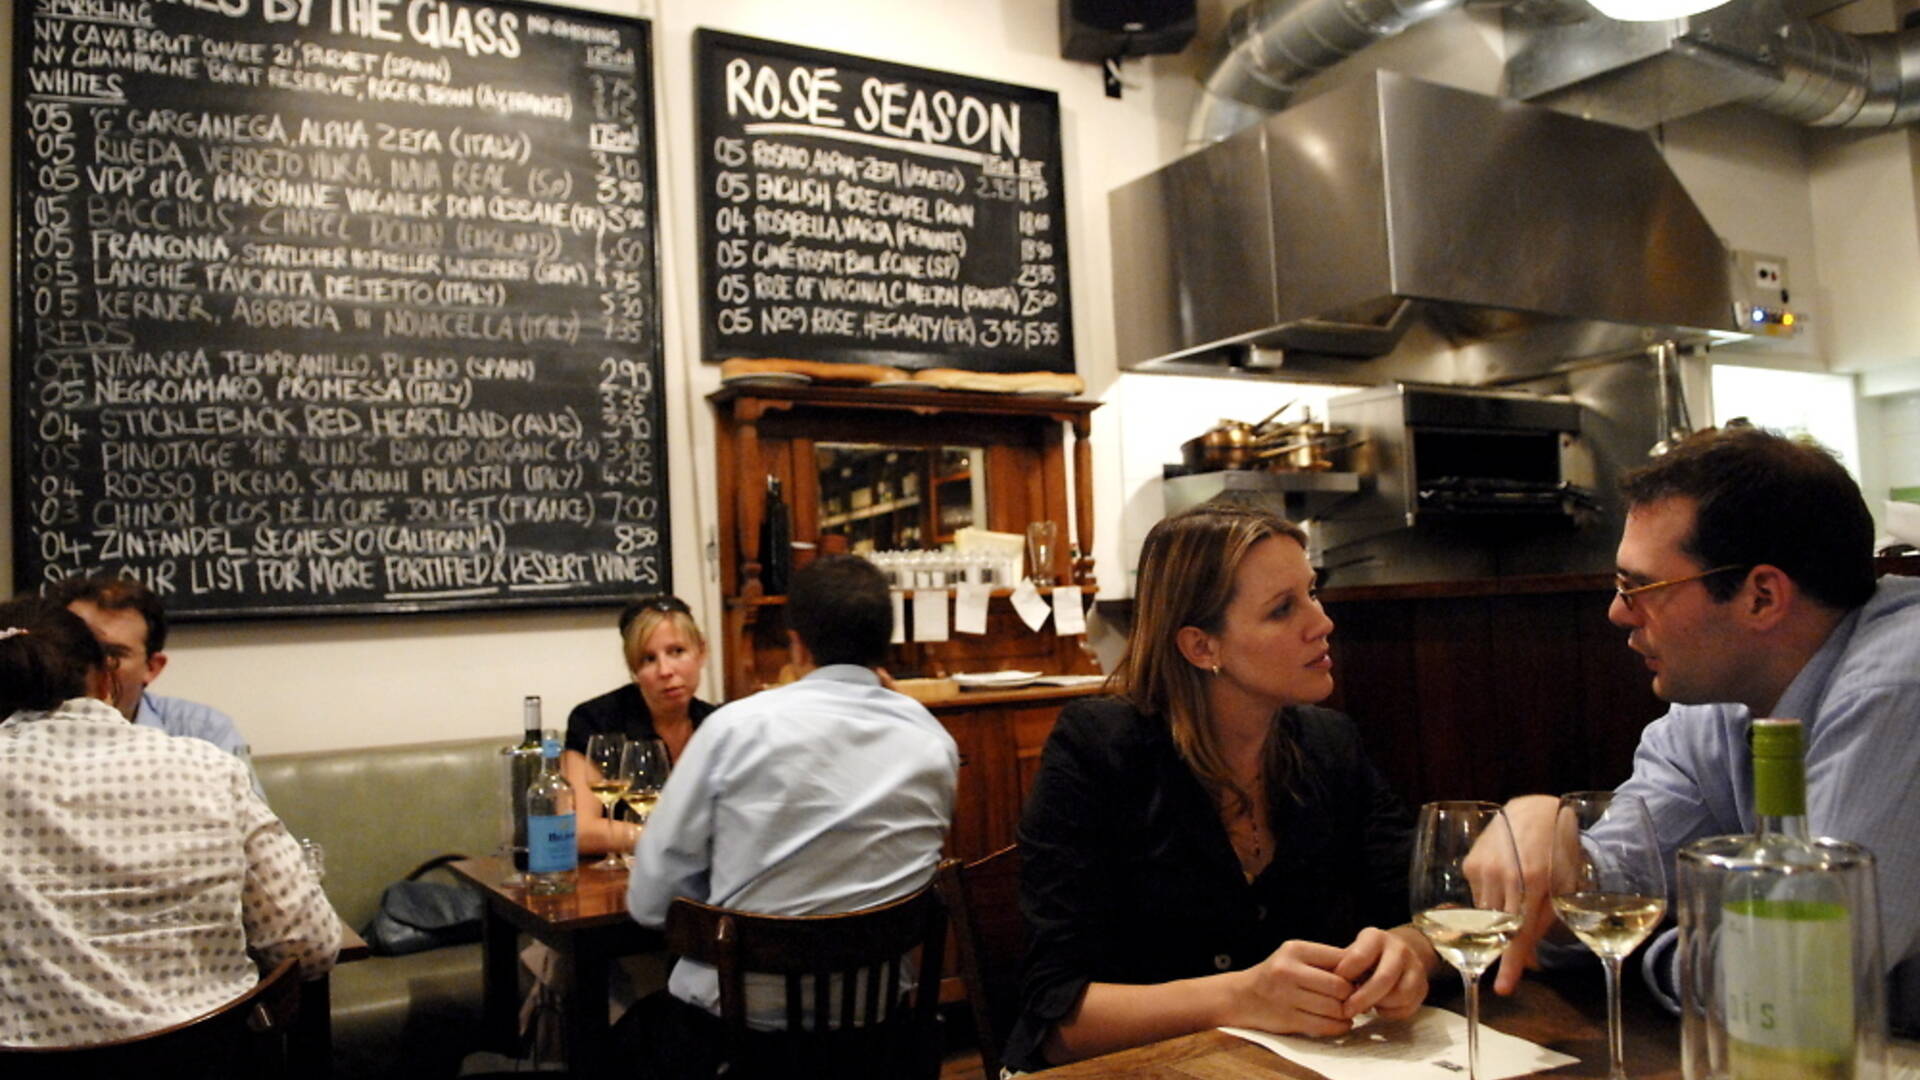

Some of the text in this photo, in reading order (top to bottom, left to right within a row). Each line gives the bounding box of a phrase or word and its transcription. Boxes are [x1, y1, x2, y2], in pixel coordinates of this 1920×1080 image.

[34, 20, 65, 43] NV
[72, 24, 129, 48] CAVA
[133, 28, 195, 55] BRUT
[407, 0, 521, 58] GLASS
[33, 46, 65, 65] NV
[71, 48, 199, 79] CHAMPAGNE
[28, 68, 124, 98] WHITES
[854, 77, 1021, 158] SEASON
[300, 117, 370, 149] ALPHA
[376, 122, 443, 154] ZETA
[449, 126, 533, 167] (ITALY)
[713, 136, 748, 168] 05
[94, 137, 188, 172] RUEDA
[199, 146, 303, 181] VERDEJO
[452, 158, 512, 195] REAL
[86, 164, 147, 198] VDP
[446, 194, 488, 220] DOM
[715, 170, 751, 203] 05
[755, 172, 832, 213] ENGLISH
[715, 206, 749, 237] 04
[716, 238, 749, 270] 05
[93, 259, 197, 291] LANGHE
[205, 261, 322, 301] FAVORITA
[436, 279, 506, 308] (ITALY)
[717, 273, 750, 306] 05
[36, 317, 135, 349] REDS
[231, 295, 342, 334] ABBAZIA
[384, 309, 513, 341] NOVACELLA
[519, 308, 582, 347] (ITALY)
[718, 308, 754, 336] 05
[863, 312, 942, 343] HEGARTY
[91, 346, 211, 379] NAVARRA
[381, 350, 459, 380] PLENO
[465, 355, 536, 383] (SPAIN)
[277, 374, 404, 401] PROMESSA
[405, 376, 473, 410] (ITALY)
[100, 406, 299, 438] STICKLEBACK
[303, 403, 363, 438] RED
[369, 405, 510, 438] HEARTLAND
[511, 405, 583, 441] (AUS)
[101, 438, 236, 471] PINOTAGE
[432, 441, 472, 466] CAP
[473, 438, 559, 466] ORGANIC
[103, 470, 197, 499] ROSSO
[308, 468, 410, 495] SALADINI
[422, 464, 511, 495] PILASTRI
[92, 499, 196, 529] CHINON
[278, 498, 312, 525] DE
[498, 491, 597, 528] (FRANCE)
[92, 526, 248, 561] ZINFANDEL
[191, 555, 251, 595] LIST
[256, 558, 305, 594] FOR
[308, 556, 377, 595] MORE
[383, 551, 491, 592] FORTIFIED
[591, 551, 659, 585] WINES
